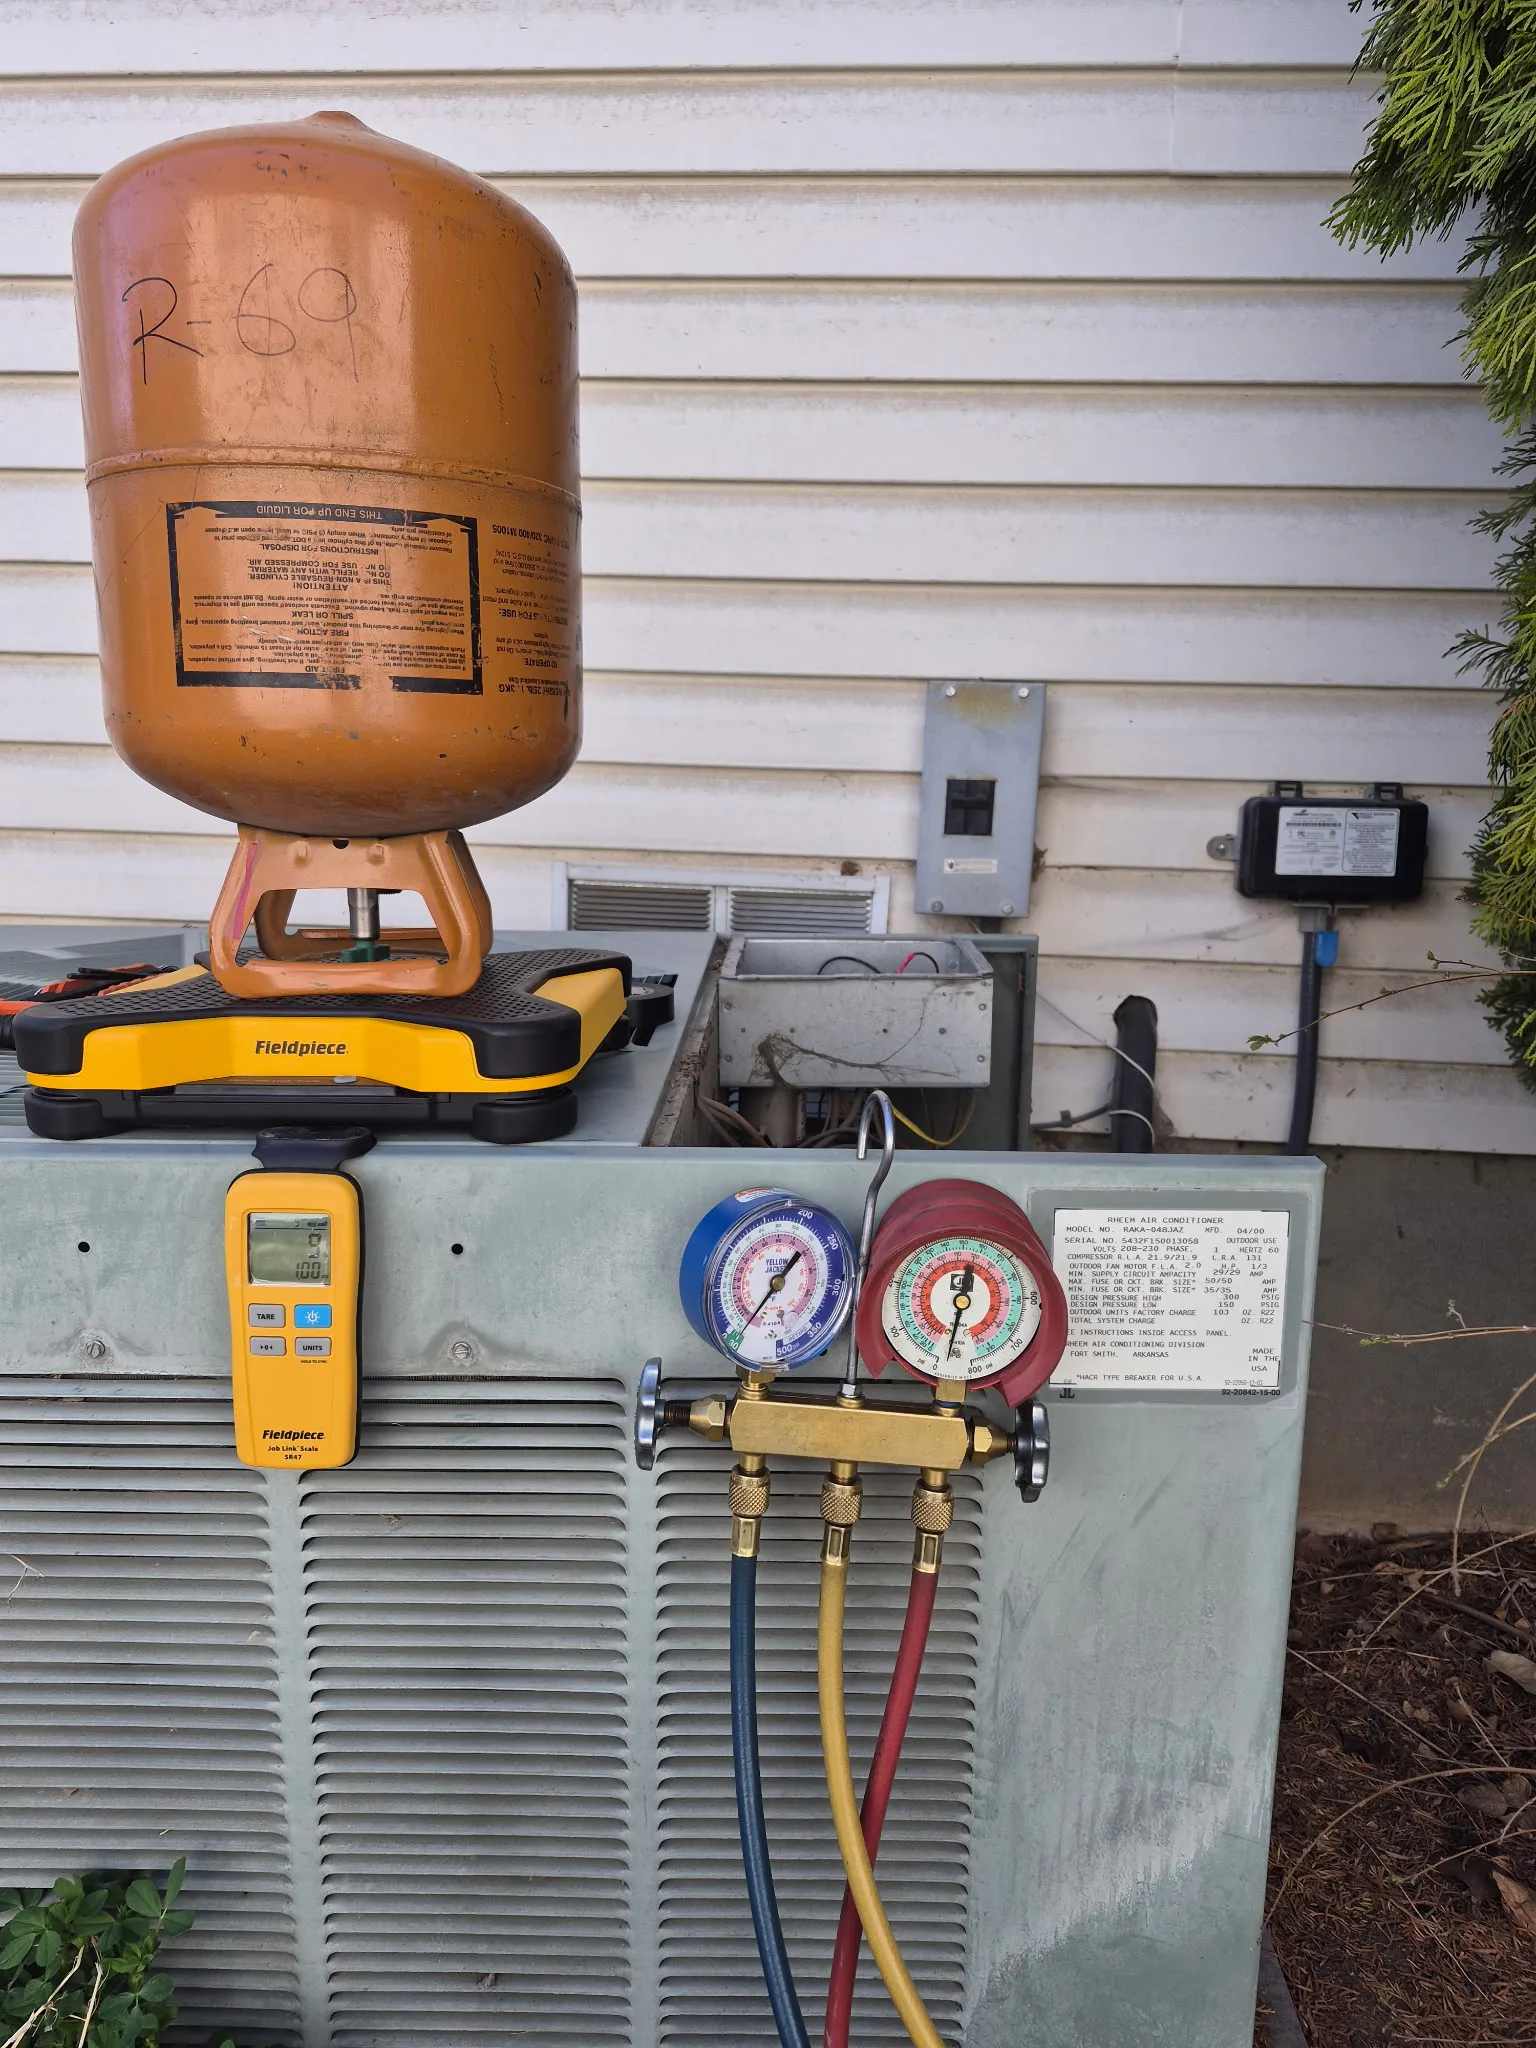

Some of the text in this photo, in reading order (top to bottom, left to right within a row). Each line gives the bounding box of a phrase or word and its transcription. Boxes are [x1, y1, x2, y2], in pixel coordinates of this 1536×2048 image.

[122, 263, 359, 385] R-69
[256, 505, 382, 520] THIS END UP FOR LIQUID
[492, 525, 517, 536] M1005
[259, 543, 300, 551] DISPOSAL
[320, 546, 379, 555] INSTRUCTIONS
[265, 559, 320, 567] COMPRESSED
[291, 574, 354, 583] NON-REUSABLE
[293, 582, 348, 591] ATTENTION!
[498, 609, 516, 618] USE:
[255, 1040, 347, 1056] Fieldpiece
[798, 1209, 813, 1219] 200
[827, 1233, 838, 1250] 250
[832, 1279, 841, 1296] 300
[807, 1322, 822, 1338] 350
[890, 1326, 899, 1338] 100
[728, 1340, 739, 1350] 30
[777, 1344, 793, 1356] 500
[1011, 1338, 1022, 1351] 700
[968, 1366, 982, 1374] 800
[262, 1430, 324, 1441] Fieldpiece
